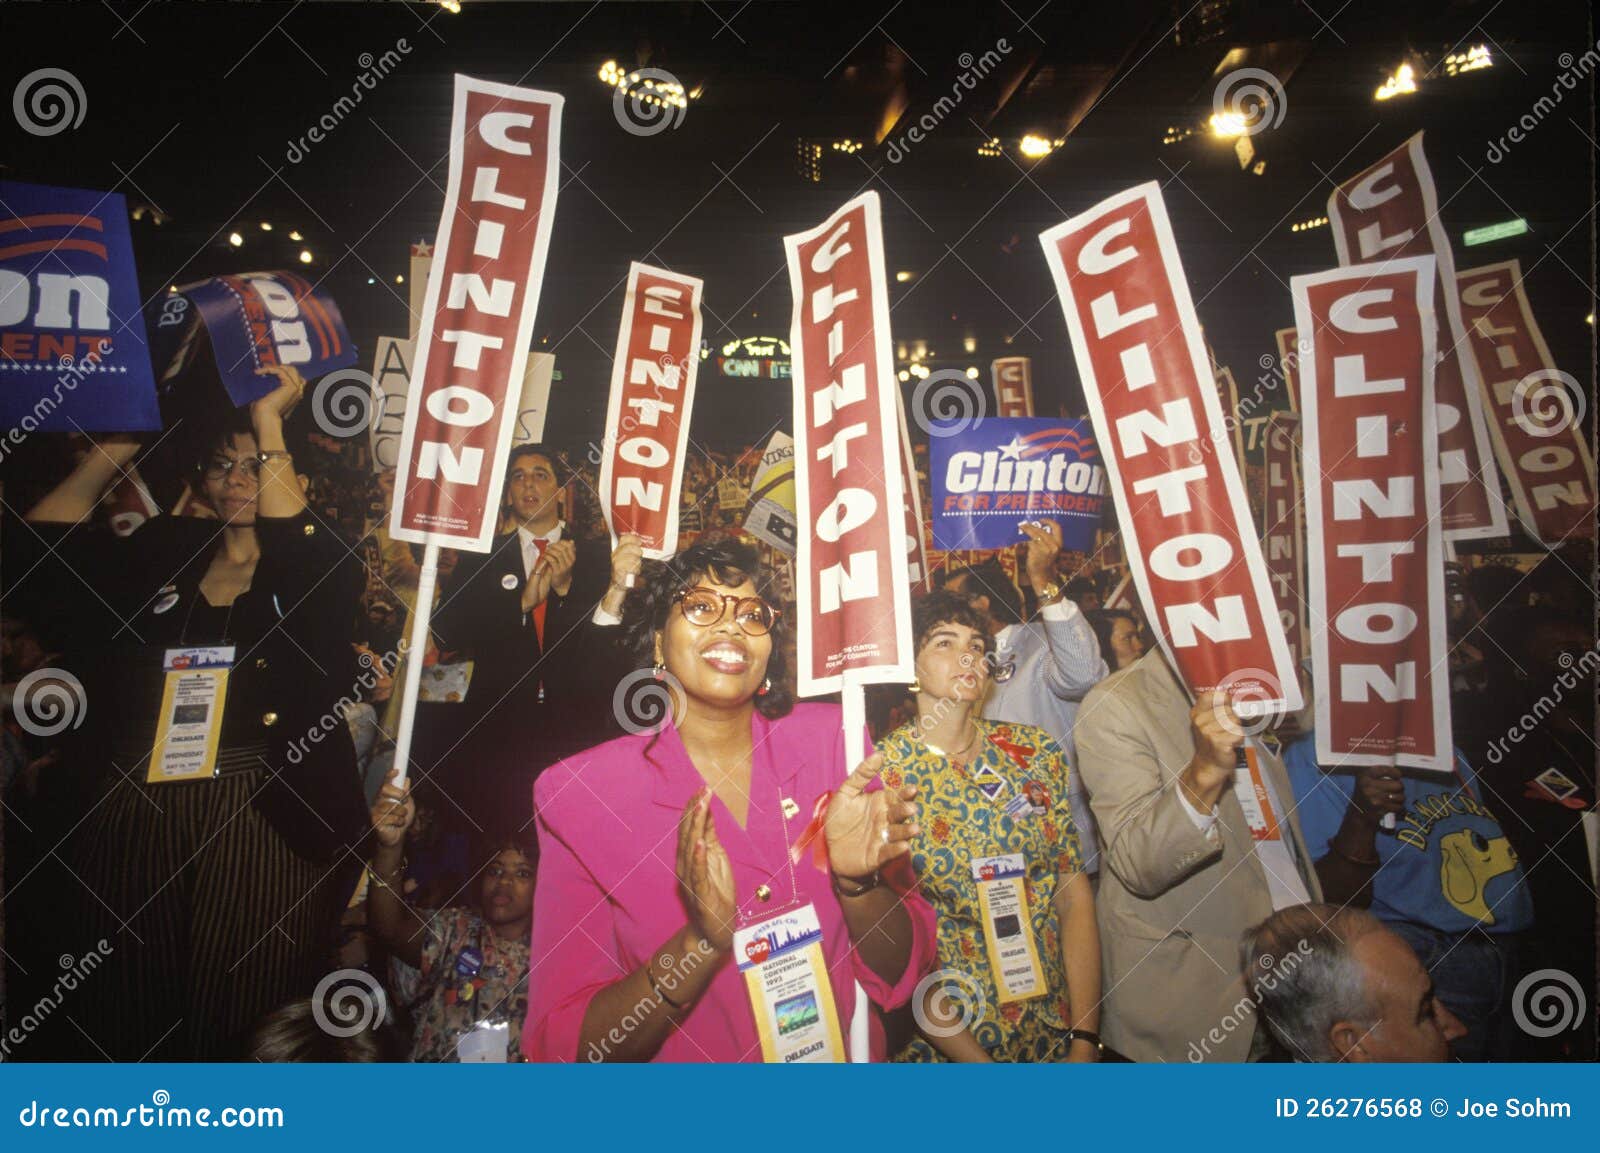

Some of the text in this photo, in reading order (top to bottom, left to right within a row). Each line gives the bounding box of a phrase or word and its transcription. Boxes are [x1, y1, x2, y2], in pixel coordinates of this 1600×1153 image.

[416, 112, 535, 486] CLINTON
[812, 221, 880, 614] CLINTON
[1078, 218, 1252, 648] CLINTON
[944, 494, 989, 510] FOR
[1328, 288, 1418, 703] CLINTON
[785, 1040, 825, 1063] DELEGATE
